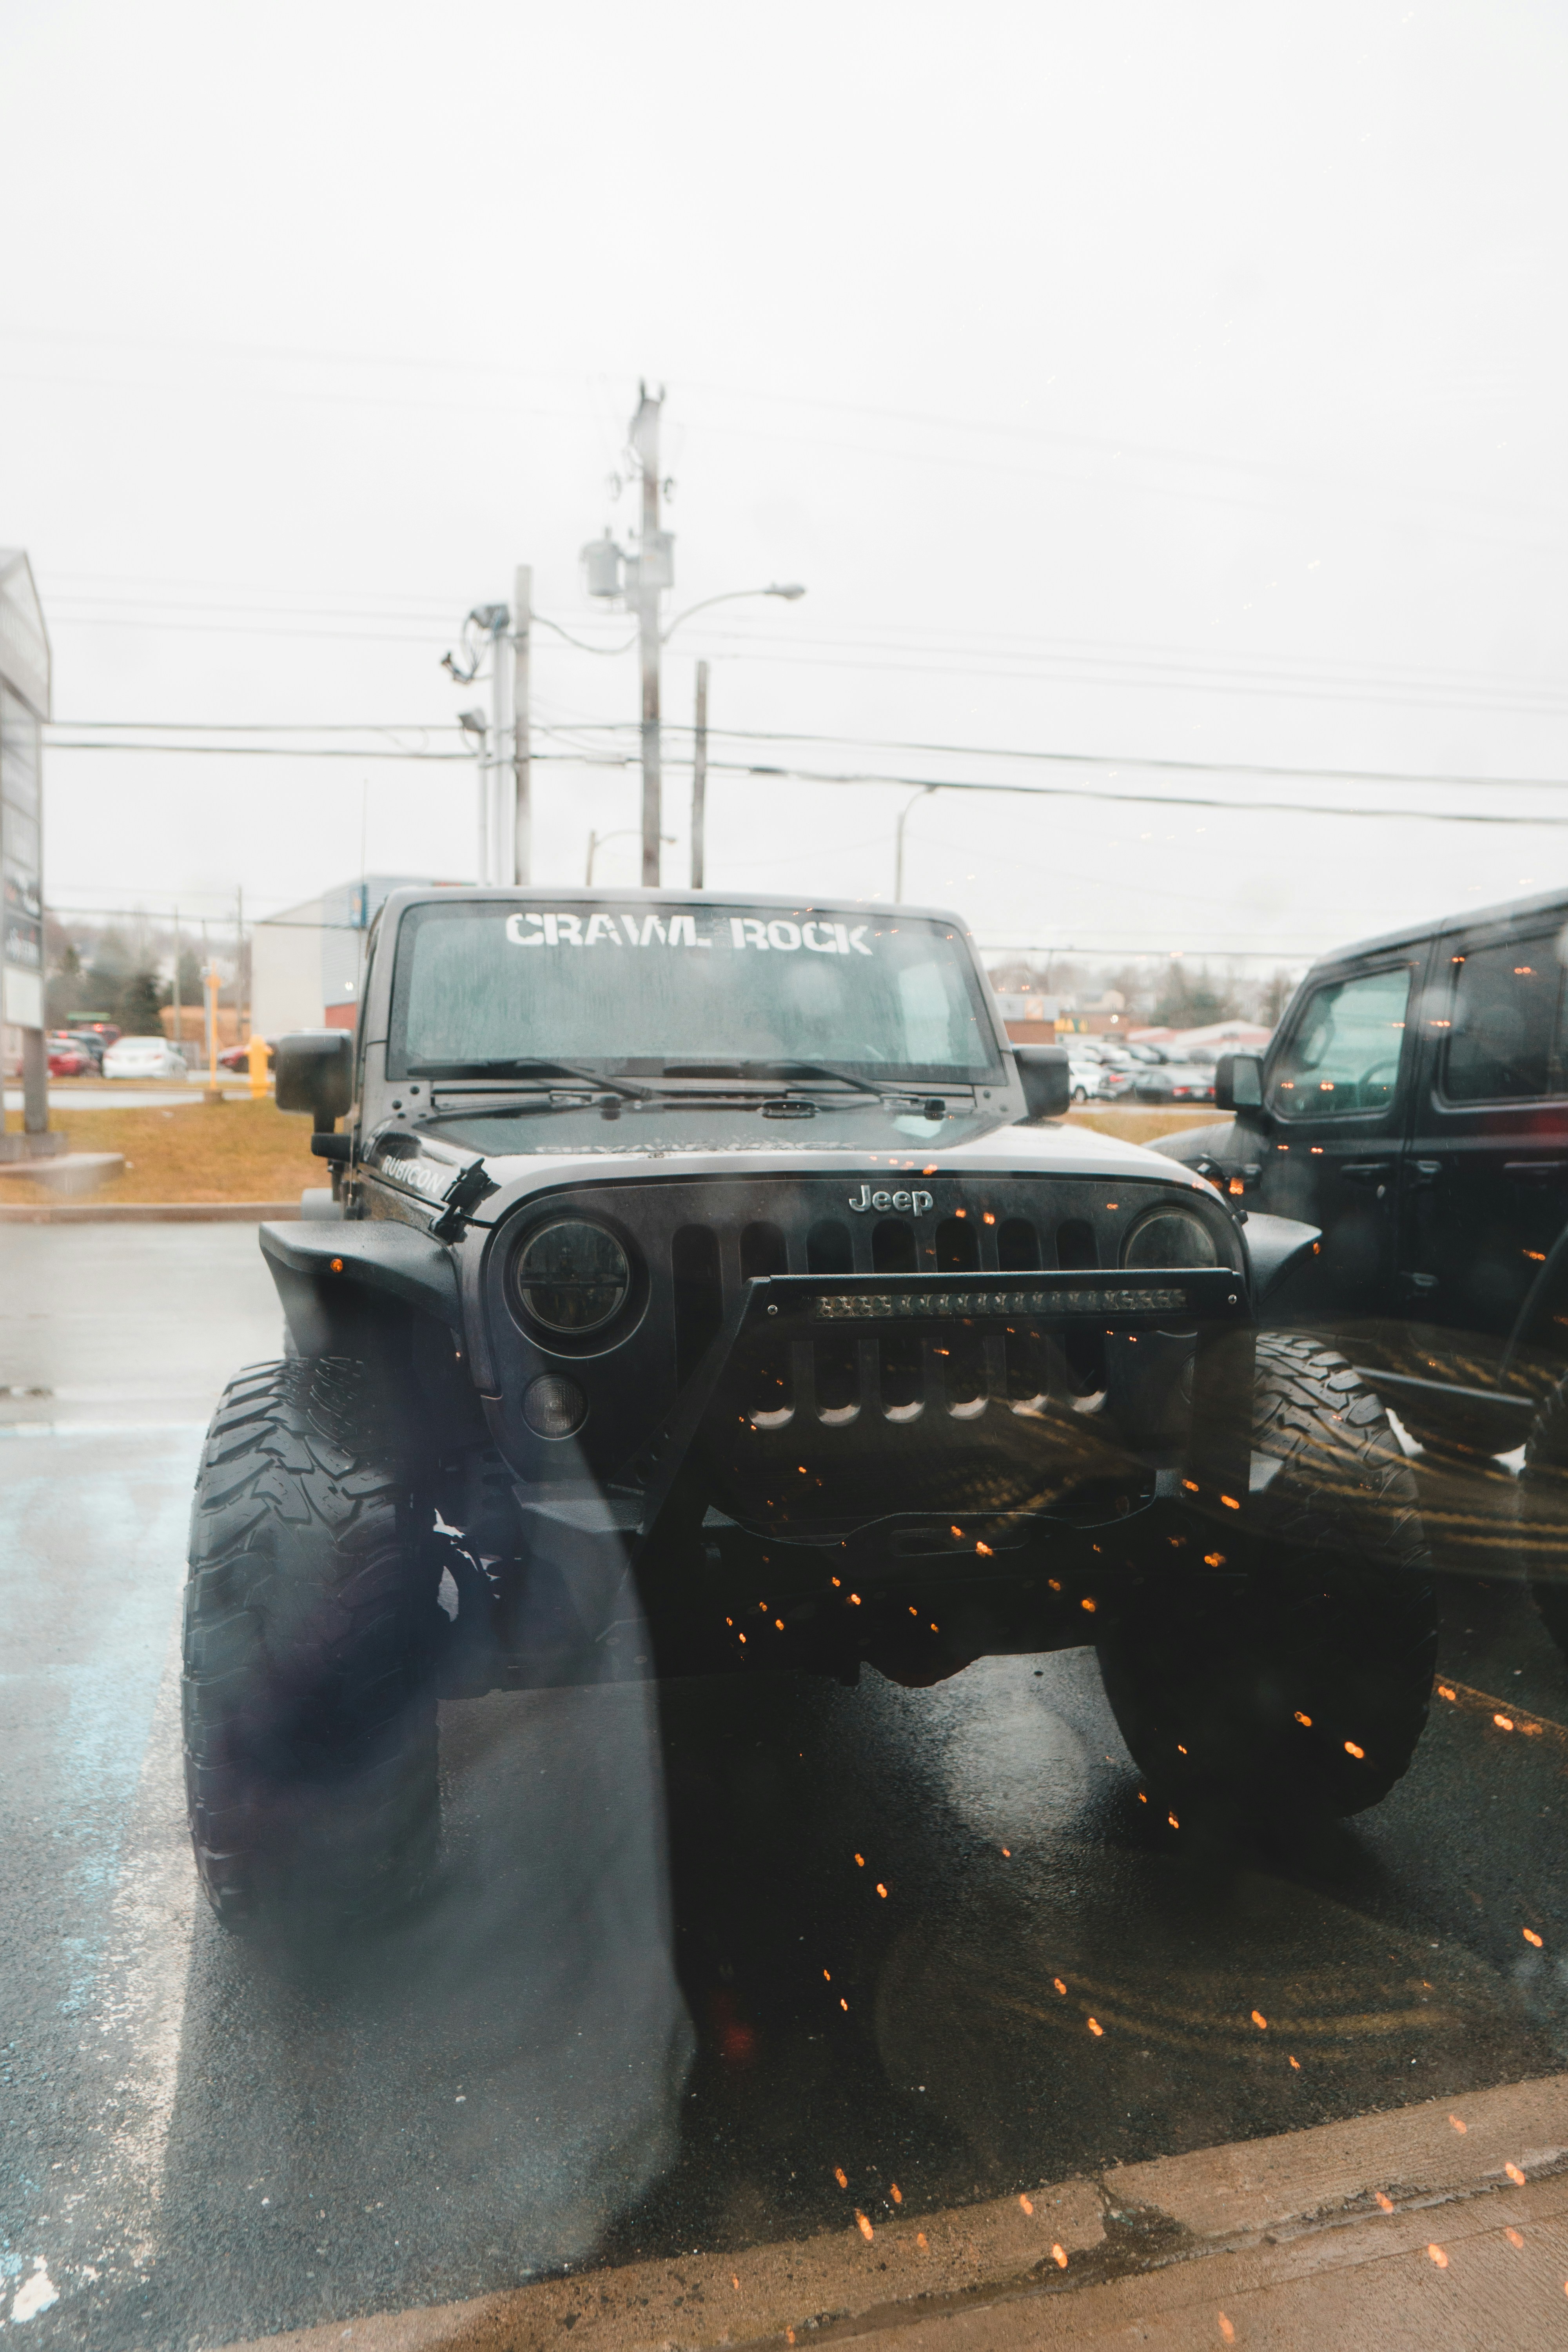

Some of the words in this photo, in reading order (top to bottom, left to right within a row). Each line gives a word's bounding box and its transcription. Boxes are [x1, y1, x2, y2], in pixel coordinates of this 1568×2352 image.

[505, 913, 713, 948] CRAWL
[730, 917, 873, 956] ROCK
[381, 1155, 446, 1193] RUBICON
[849, 1185, 933, 1217] Jeep
